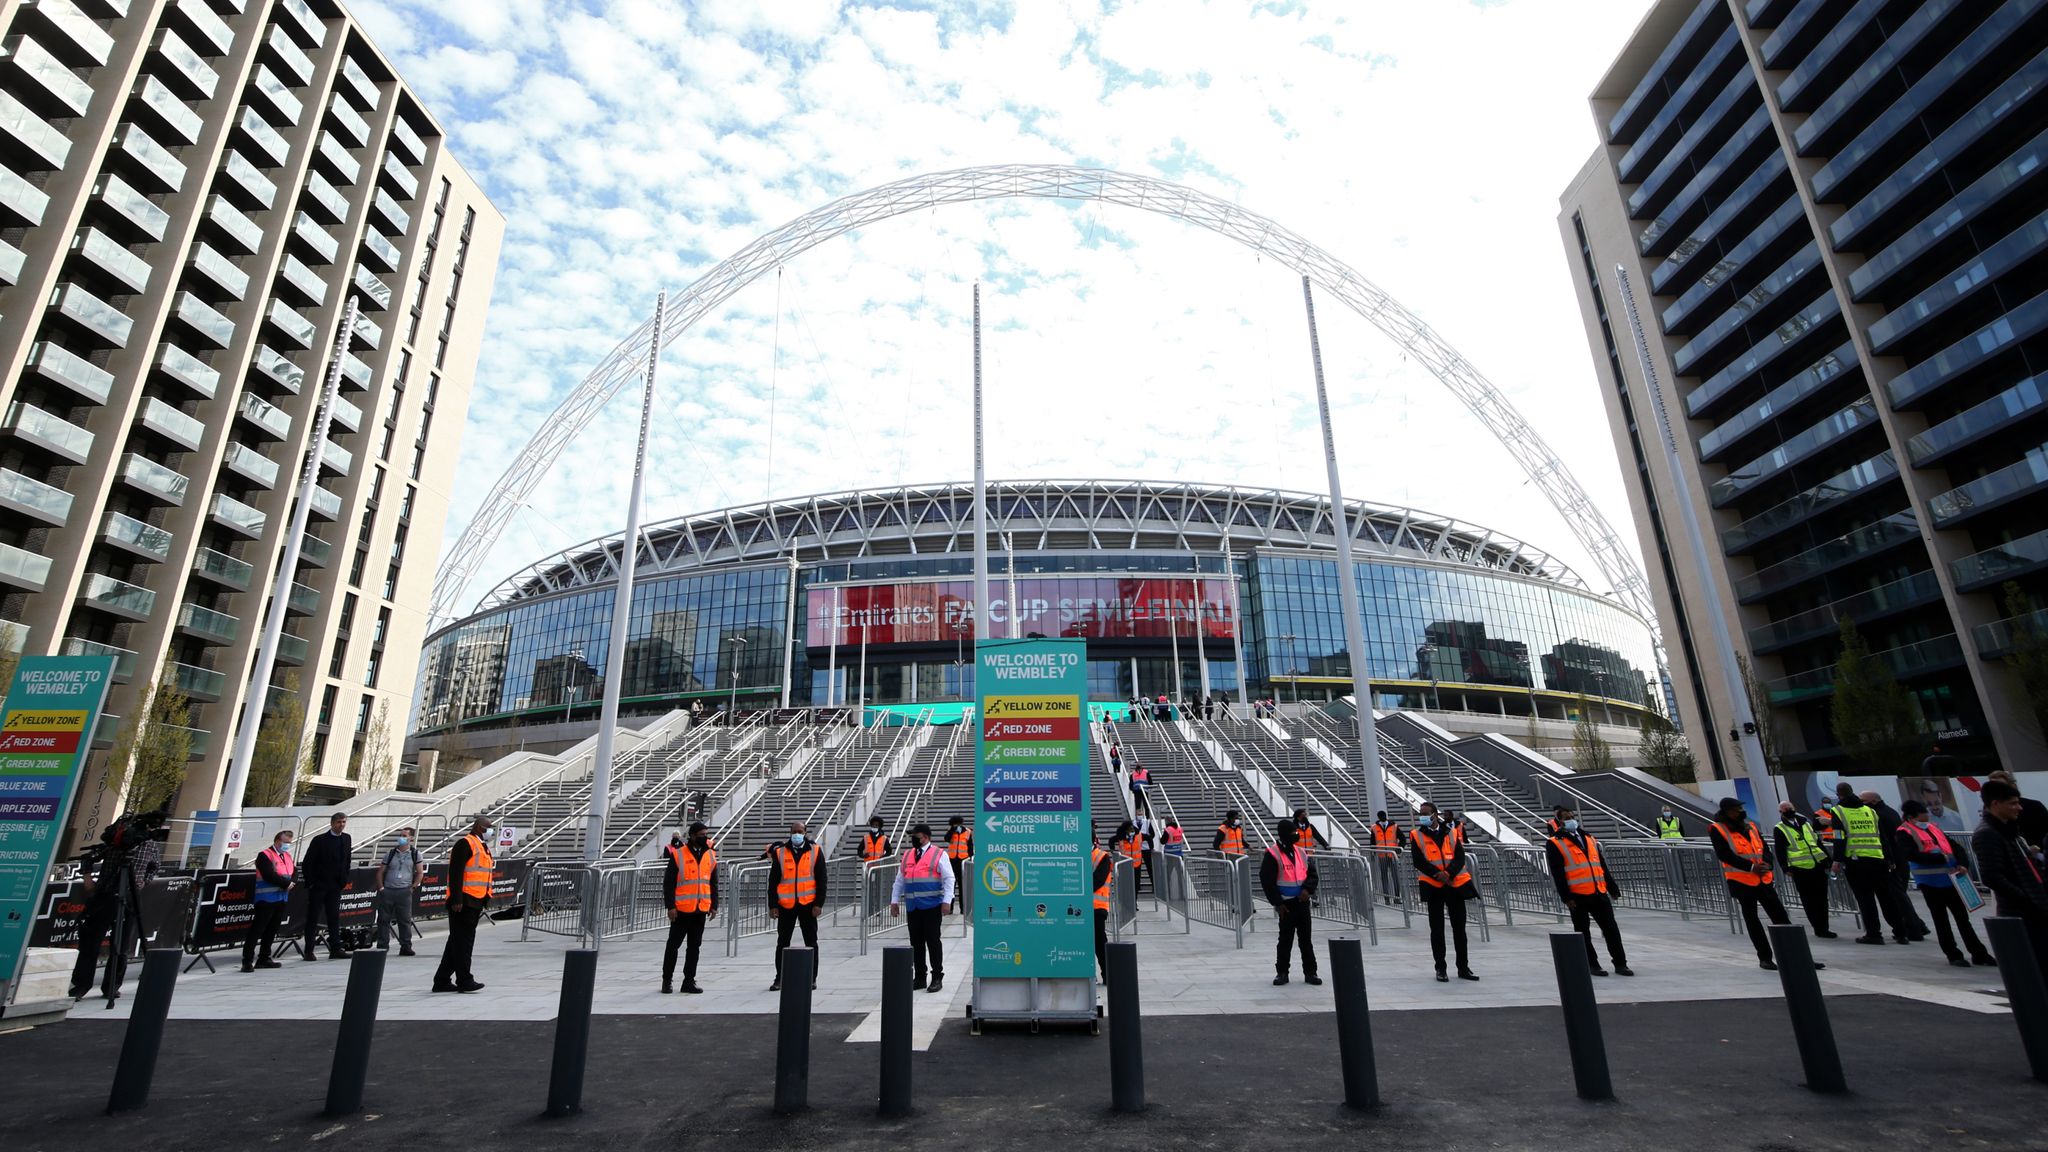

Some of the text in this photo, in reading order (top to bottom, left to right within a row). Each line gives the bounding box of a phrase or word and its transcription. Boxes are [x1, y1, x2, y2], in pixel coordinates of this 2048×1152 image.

[836, 597, 1233, 628] Emirates FA CUP SEMI-FINAL
[984, 653, 1078, 667] WELCOME TO
[21, 670, 101, 683] WELCOME TO
[995, 667, 1067, 679] WEMBLEY
[26, 683, 88, 695] WEMBLEY
[1003, 702, 1072, 711] YELLOW ZONE
[21, 716, 80, 725] YELLOW ZONE
[1003, 725, 1052, 734] RED ZONE
[1938, 729, 1968, 740] Alameda
[14, 738, 56, 747] RED ZONE
[1003, 748, 1066, 757] GREEN ZONE
[6, 760, 60, 769] GREEN ZONE
[1003, 771, 1058, 780] BLUE ZONE
[0, 782, 47, 791] BLUE ZONE
[1003, 795, 1073, 804] PURPLE ZONE
[27, 804, 51, 814] ZONE
[1003, 815, 1061, 824] ACCESSIBLE
[0, 823, 34, 832] ESSIBLE
[1003, 825, 1035, 834] ROUTE
[988, 844, 1078, 853] BAG RESTRICTIONS
[0, 851, 39, 860] RICTIONS
[220, 890, 246, 900] Closed
[354, 891, 377, 900] permitted
[217, 904, 227, 912] No
[227, 904, 248, 912] access
[342, 902, 357, 910] further
[54, 919, 66, 928] No
[215, 916, 229, 925] until
[230, 914, 251, 923] further
